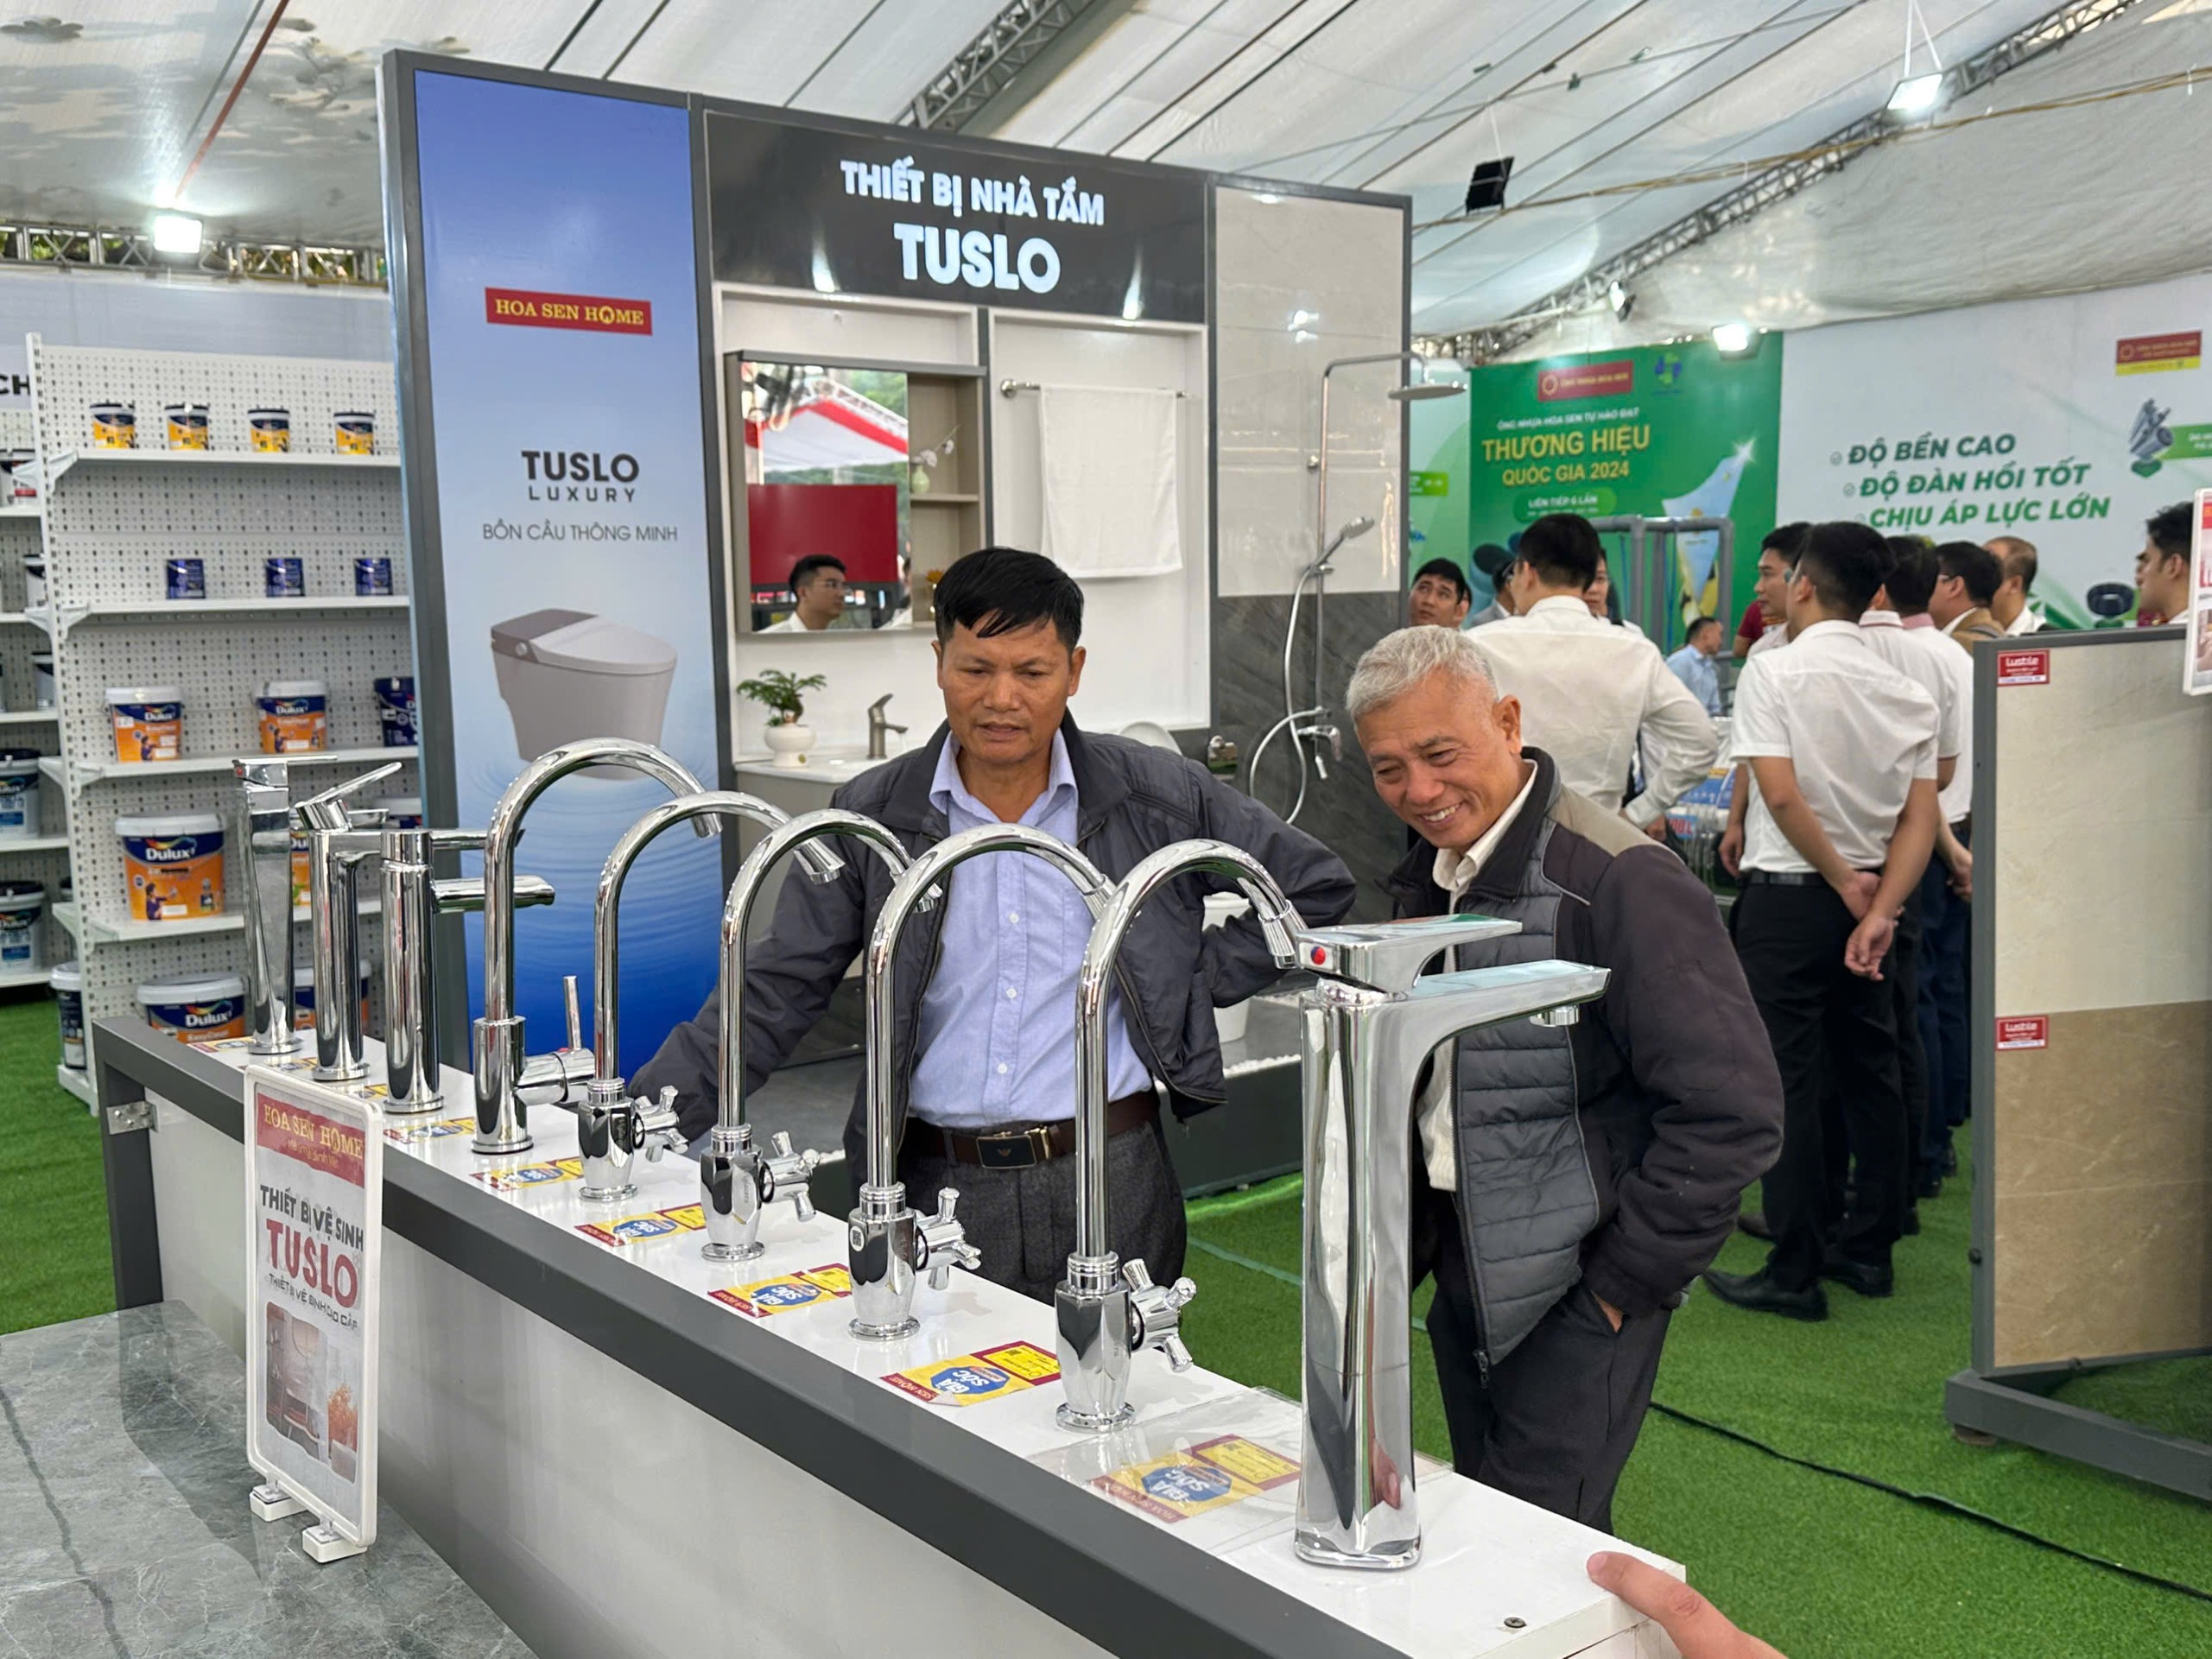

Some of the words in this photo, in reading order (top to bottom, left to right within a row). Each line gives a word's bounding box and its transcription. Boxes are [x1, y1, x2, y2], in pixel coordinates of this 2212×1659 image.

[840, 155, 924, 203] THIẾT
[933, 173, 962, 218] BỊ
[971, 174, 1037, 218] NHÀ
[894, 223, 1061, 294] TUSLO
[496, 299, 537, 318] HOA
[542, 302, 579, 320] SEN
[585, 306, 643, 325] HOME
[1482, 431, 1584, 462] THƯƠNG
[1592, 424, 1651, 456] HIỆU
[1848, 437, 1888, 469] ĐỘ
[1956, 433, 2016, 457] CAO
[522, 450, 640, 483] TUSLO
[1556, 464, 1585, 482] GIA
[1590, 460, 1630, 479] 2024
[1860, 471, 1899, 503] ĐỘ
[1906, 464, 1965, 494] ĐÀN
[2033, 456, 2090, 486] TỐT
[529, 486, 636, 502] LUXURY
[1869, 501, 1933, 534] CHỊU
[1938, 499, 1978, 524] ÁP
[1986, 499, 2041, 529] LỰC
[2049, 491, 2111, 519] LỚN
[571, 521, 631, 541] THÔNG
[636, 526, 678, 541] MINH
[145, 848, 191, 861] Dulux
[185, 1013, 229, 1028] Dulux
[264, 1105, 291, 1130] HOA
[292, 1115, 315, 1141] SEN
[320, 1125, 363, 1159] HOME
[260, 1184, 296, 1219] THIẾT
[301, 1200, 312, 1232] BỊ
[312, 1206, 333, 1241] VỆ
[336, 1220, 364, 1252] SINH
[267, 1219, 358, 1308] TUSLO
